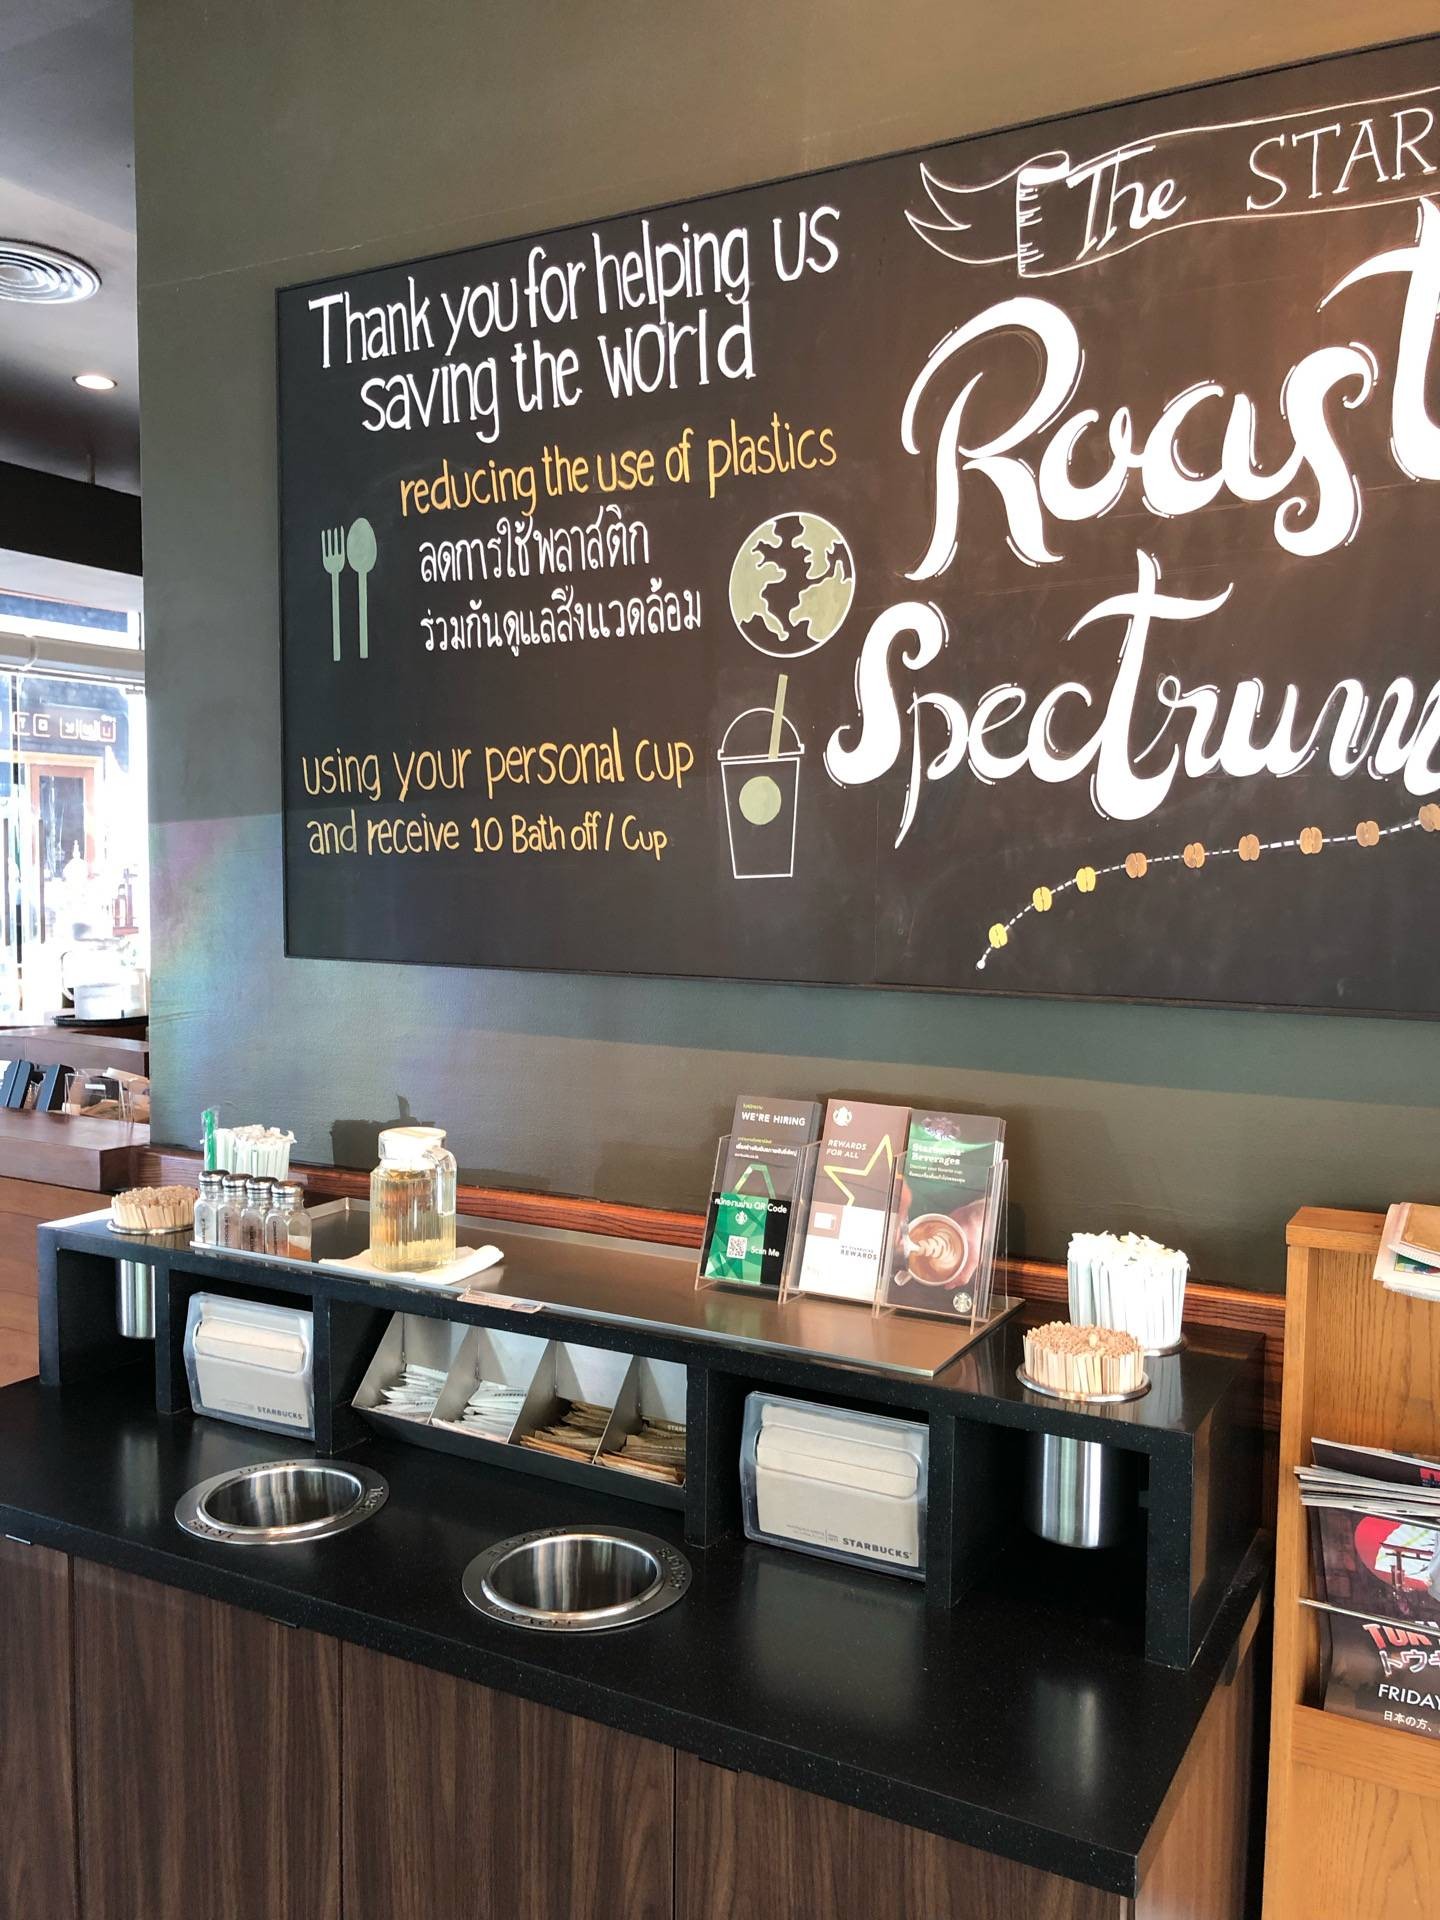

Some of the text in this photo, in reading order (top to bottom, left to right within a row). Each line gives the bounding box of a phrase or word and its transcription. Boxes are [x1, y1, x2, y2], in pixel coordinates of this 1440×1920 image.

[1067, 145, 1186, 261] The
[308, 277, 435, 369] Thank
[440, 277, 518, 356] you
[524, 246, 587, 328] for
[592, 219, 752, 325] helping
[360, 301, 756, 443] saving the world
[400, 411, 838, 519] reducing the use of plastics
[302, 746, 381, 801] using
[393, 747, 472, 803] your
[484, 727, 625, 800] personal
[307, 808, 358, 856] and
[367, 812, 460, 856] receive
[471, 816, 503, 853] 10
[512, 813, 567, 853] Bath
[621, 816, 668, 861] Cup
[741, 1111, 806, 1127] WE'RE HIRING
[826, 1148, 860, 1159] FOR ALL
[828, 1139, 867, 1151] REWARDS
[911, 1151, 961, 1167] Beverages
[767, 1203, 788, 1214] Code
[768, 1248, 780, 1258] Me
[840, 1249, 877, 1260] REWARDS
[257, 1405, 303, 1420] STARBUCKS
[842, 1537, 911, 1559] STARBUCKS
[1378, 1683, 1440, 1711] FRIDAY
